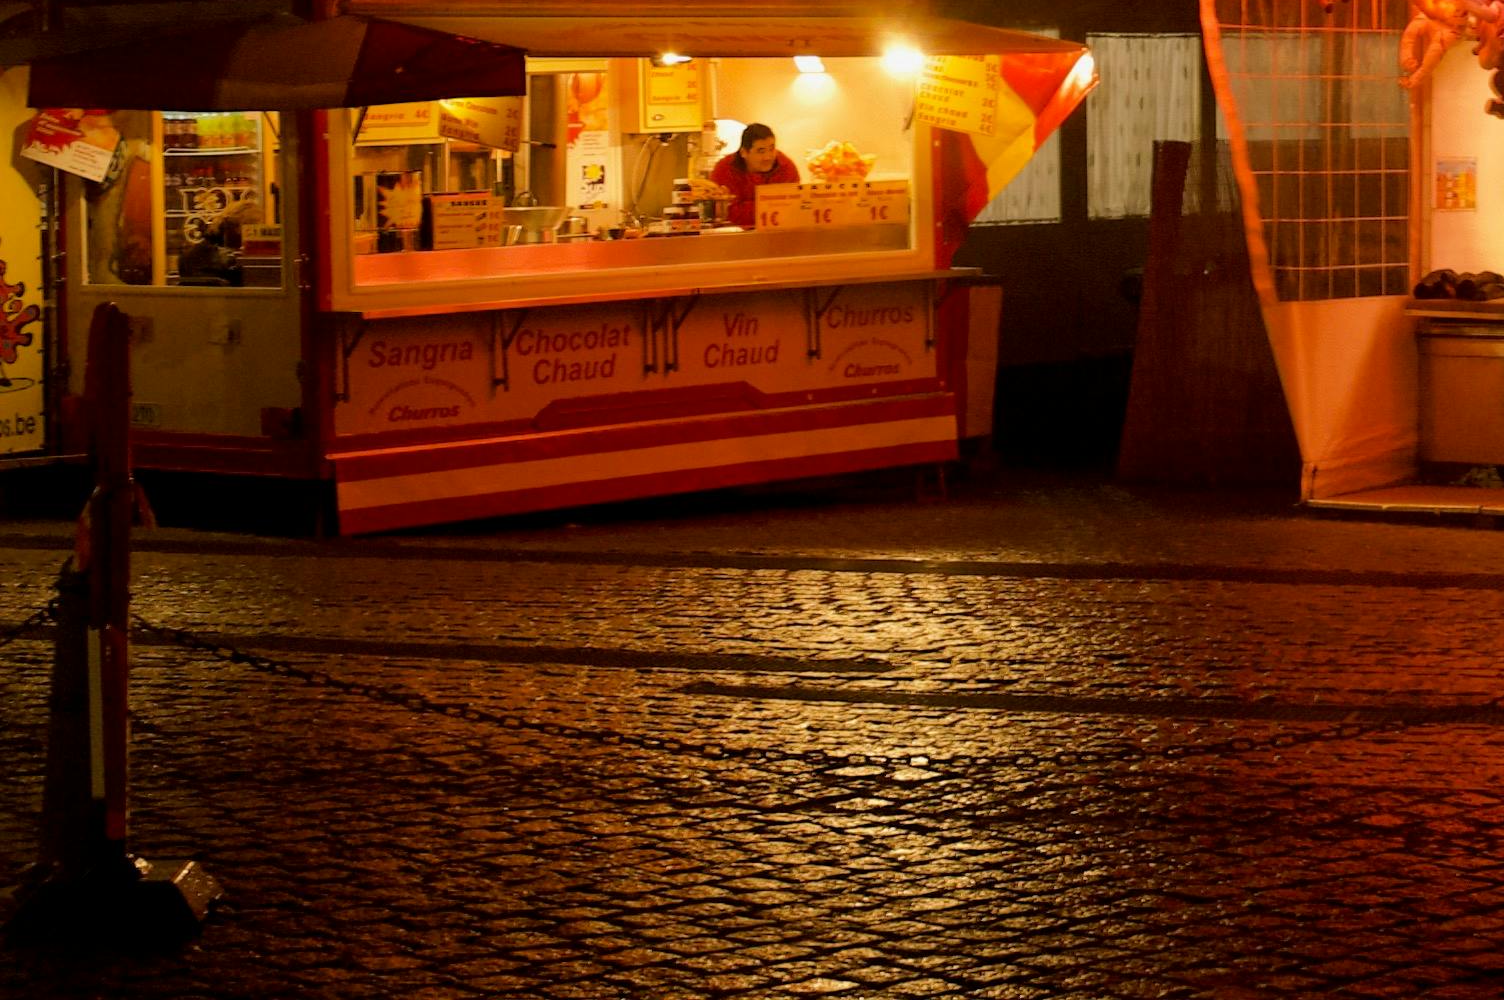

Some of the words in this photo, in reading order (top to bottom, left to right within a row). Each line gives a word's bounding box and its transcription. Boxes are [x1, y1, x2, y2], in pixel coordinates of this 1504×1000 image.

[723, 311, 760, 338] Vin
[826, 303, 913, 330] Churros
[514, 323, 632, 356] Chocolat
[368, 339, 474, 370] Sangria
[532, 352, 617, 385] Chaud
[703, 339, 781, 370] Chaud
[844, 363, 900, 379] Churros
[387, 404, 462, 423] Churros
